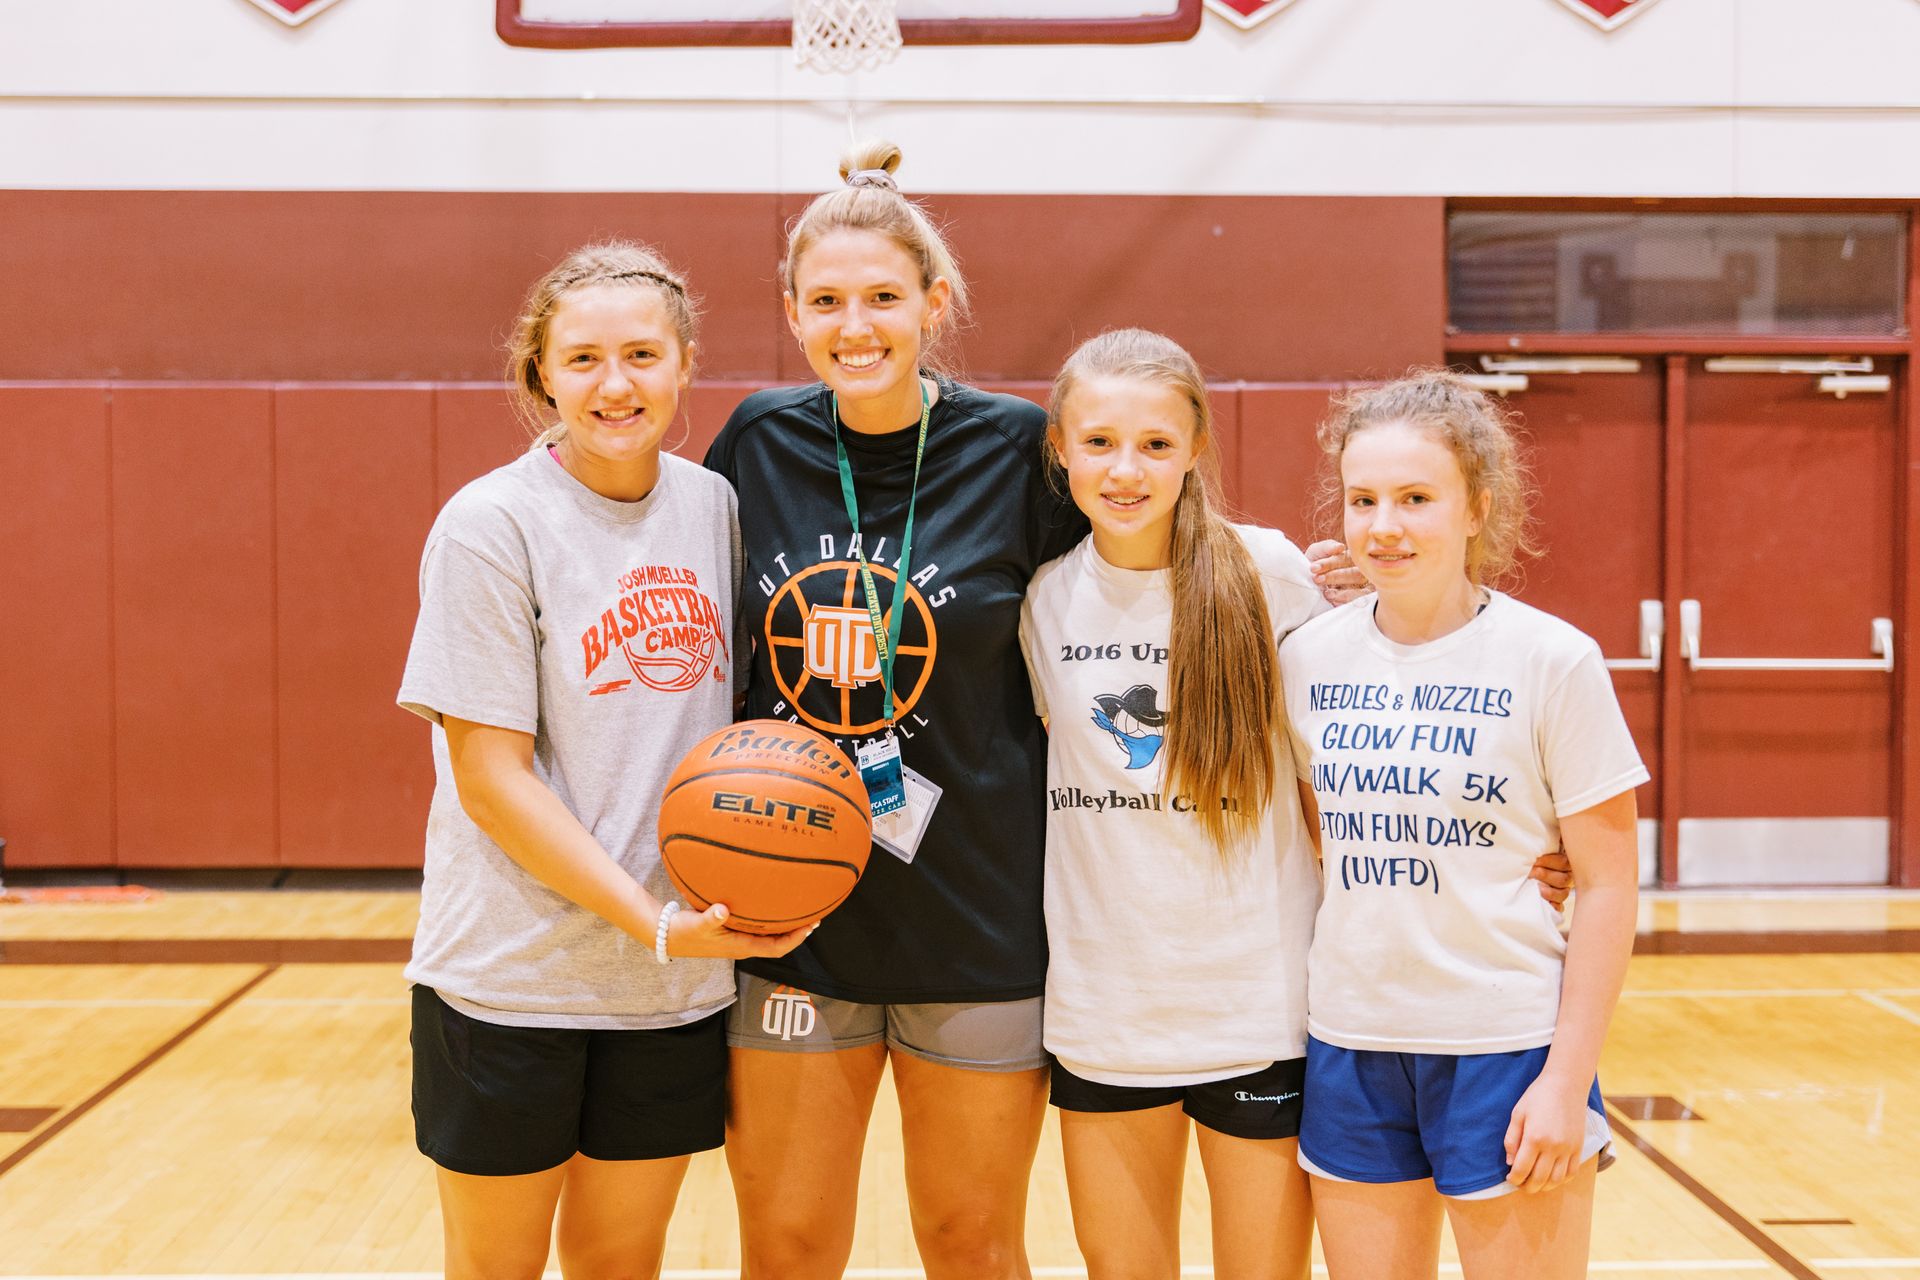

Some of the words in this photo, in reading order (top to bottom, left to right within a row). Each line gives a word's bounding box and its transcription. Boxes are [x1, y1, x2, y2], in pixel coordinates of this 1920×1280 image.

[617, 566, 647, 594] JOSH
[647, 565, 699, 588] MUELLER
[758, 552, 791, 597] UT
[819, 532, 957, 608] DALAS
[862, 567, 875, 589] HILLS
[867, 588, 880, 614] STATE
[645, 624, 702, 653] CAMP
[804, 606, 884, 689] UTD
[872, 613, 889, 661] UNIVERSITY
[1060, 643, 1121, 662] 2016
[1310, 683, 1388, 712] NEEDLES
[1392, 694, 1404, 711] &
[1410, 684, 1513, 718] NOZZLES
[710, 729, 851, 779] Baden
[1322, 722, 1406, 751] GLOW
[1410, 724, 1477, 756] FUN
[882, 794, 899, 806] STAFF
[1049, 786, 1161, 813] Volleyball
[1310, 763, 1441, 797] UN/WALK
[1462, 772, 1509, 804] 5K
[712, 792, 836, 831] ELITE
[733, 816, 775, 828] GAME
[781, 823, 816, 837] BALL
[1371, 813, 1419, 843] FUN
[1426, 816, 1497, 848] DAYS
[1341, 855, 1440, 895] (UVFD)
[762, 992, 816, 1041] UTD
[1234, 1090, 1300, 1105] Champion
